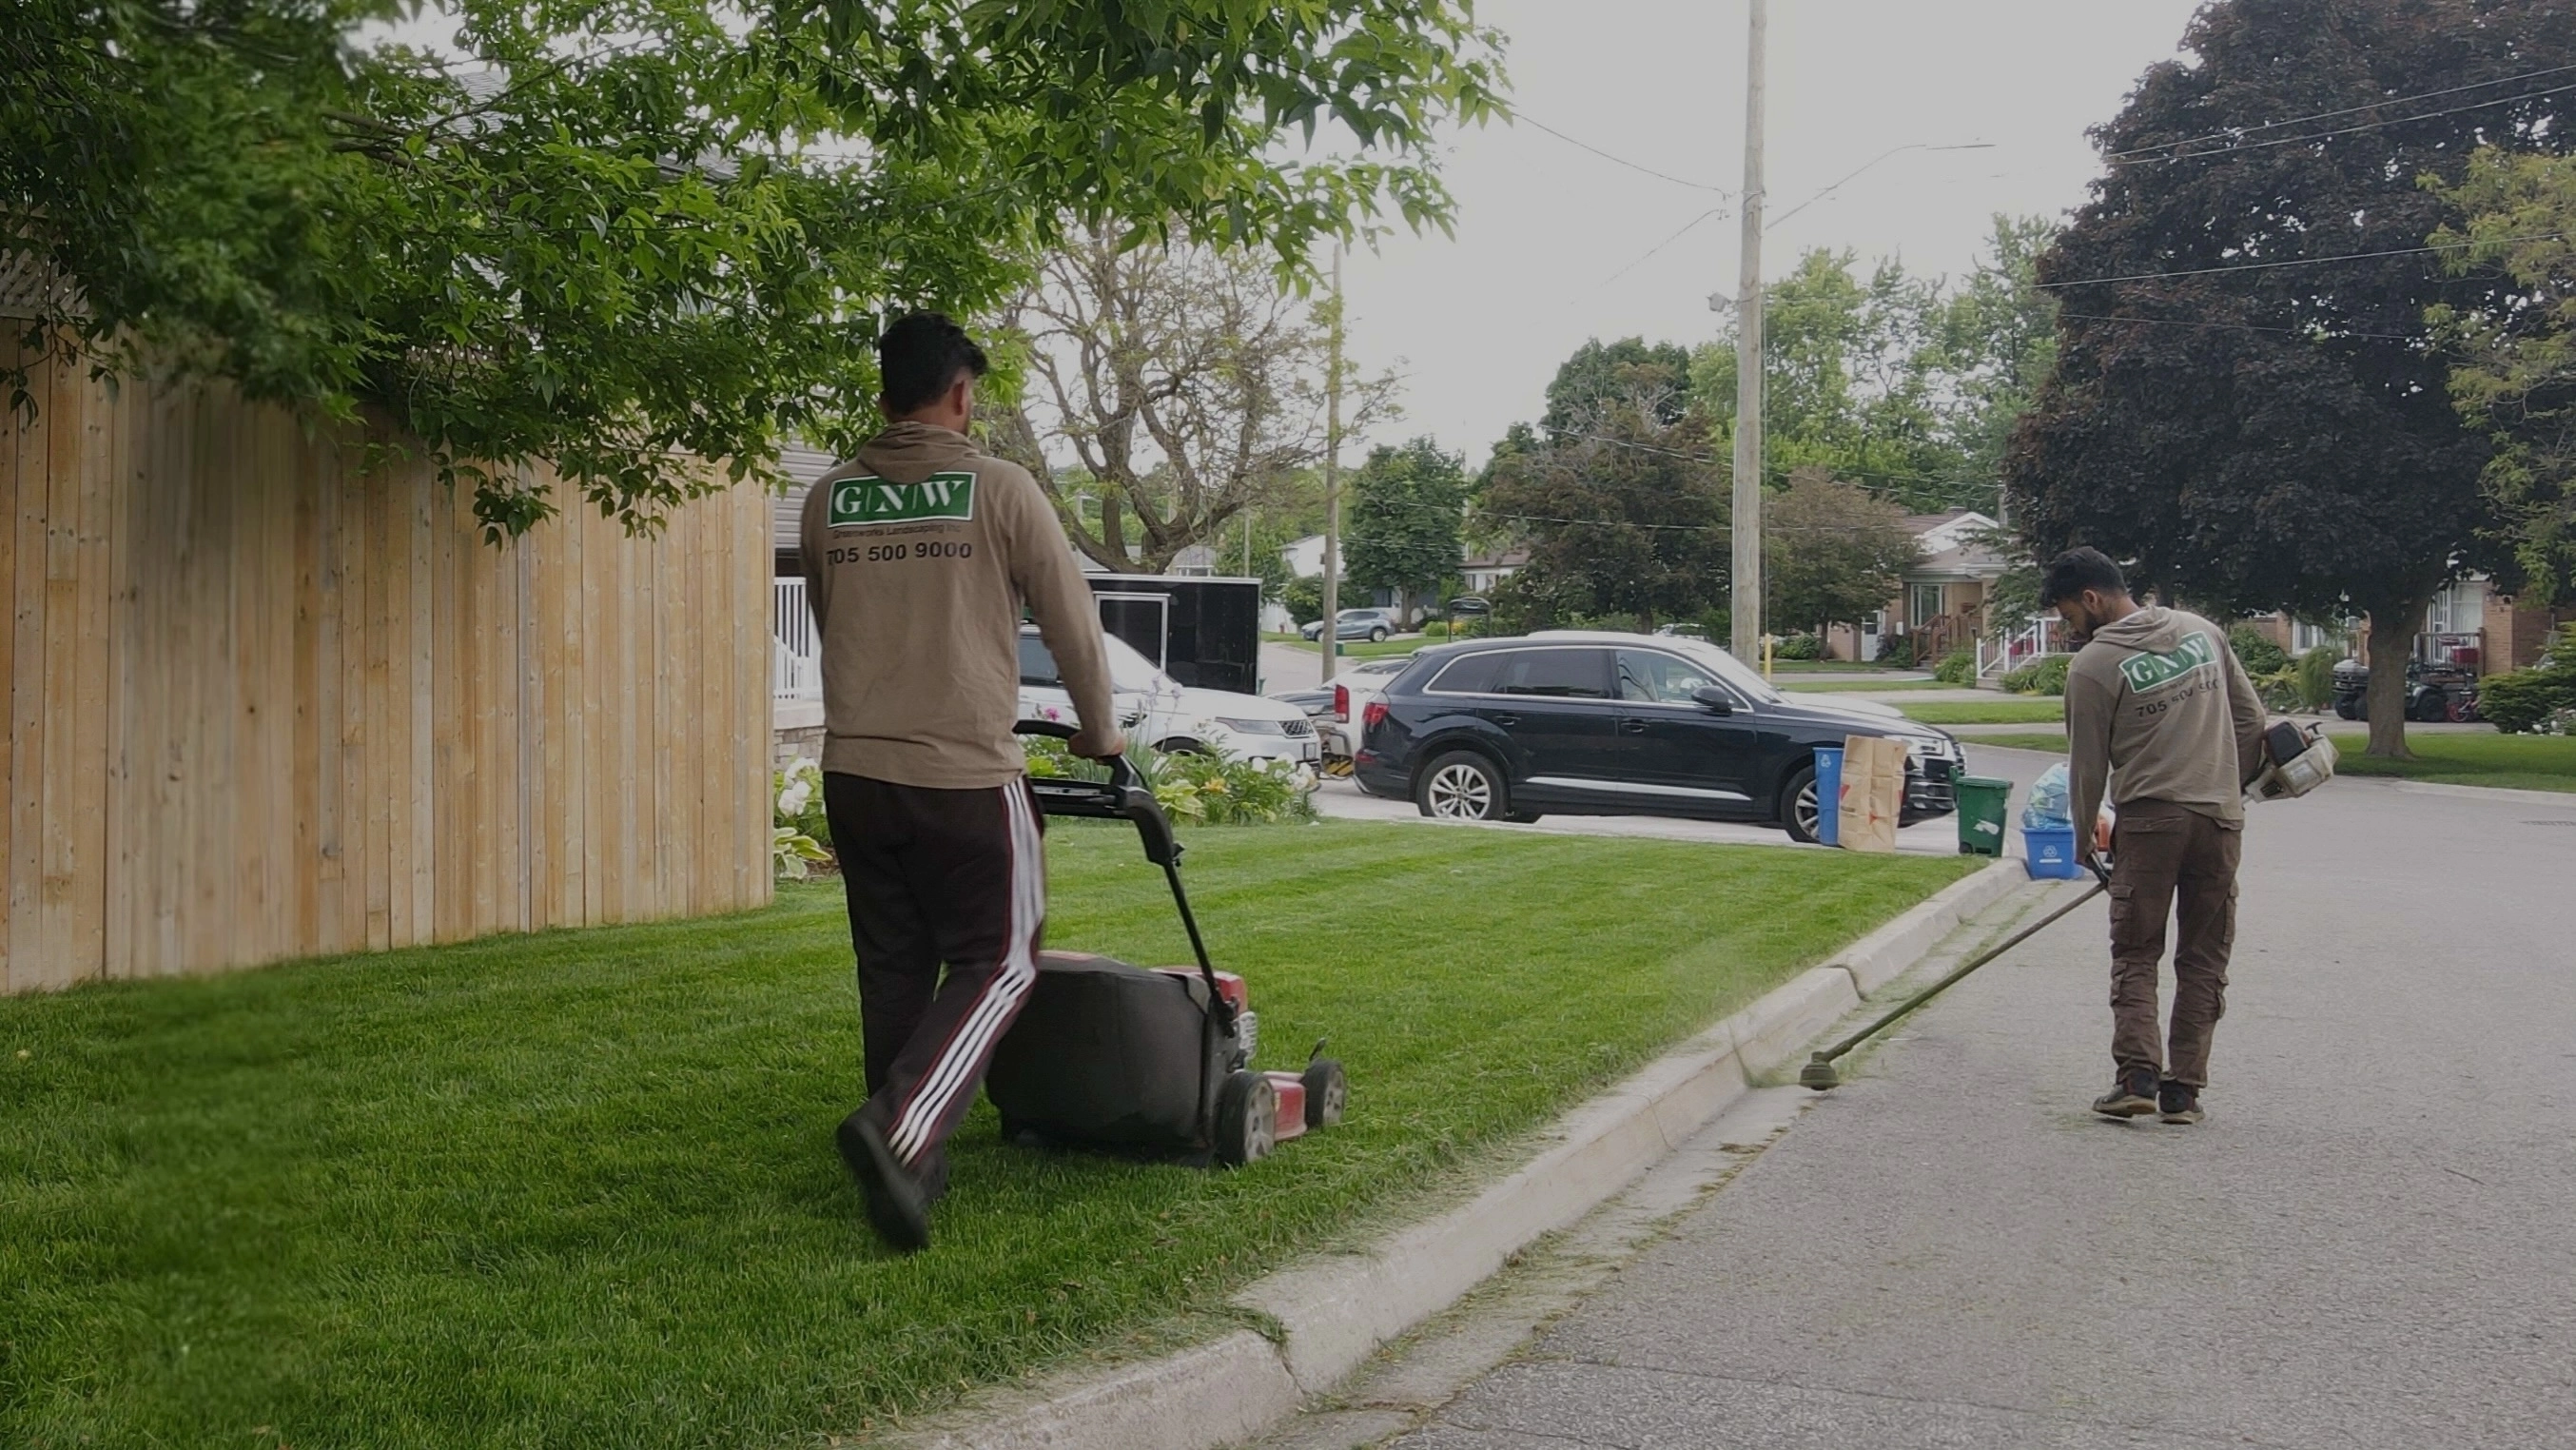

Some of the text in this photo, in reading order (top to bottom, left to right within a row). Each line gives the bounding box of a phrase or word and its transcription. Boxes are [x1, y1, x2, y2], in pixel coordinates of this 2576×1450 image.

[887, 525, 945, 536] Landscaping
[827, 541, 972, 565] 705 500 9000
[2136, 699, 2167, 717] 705
